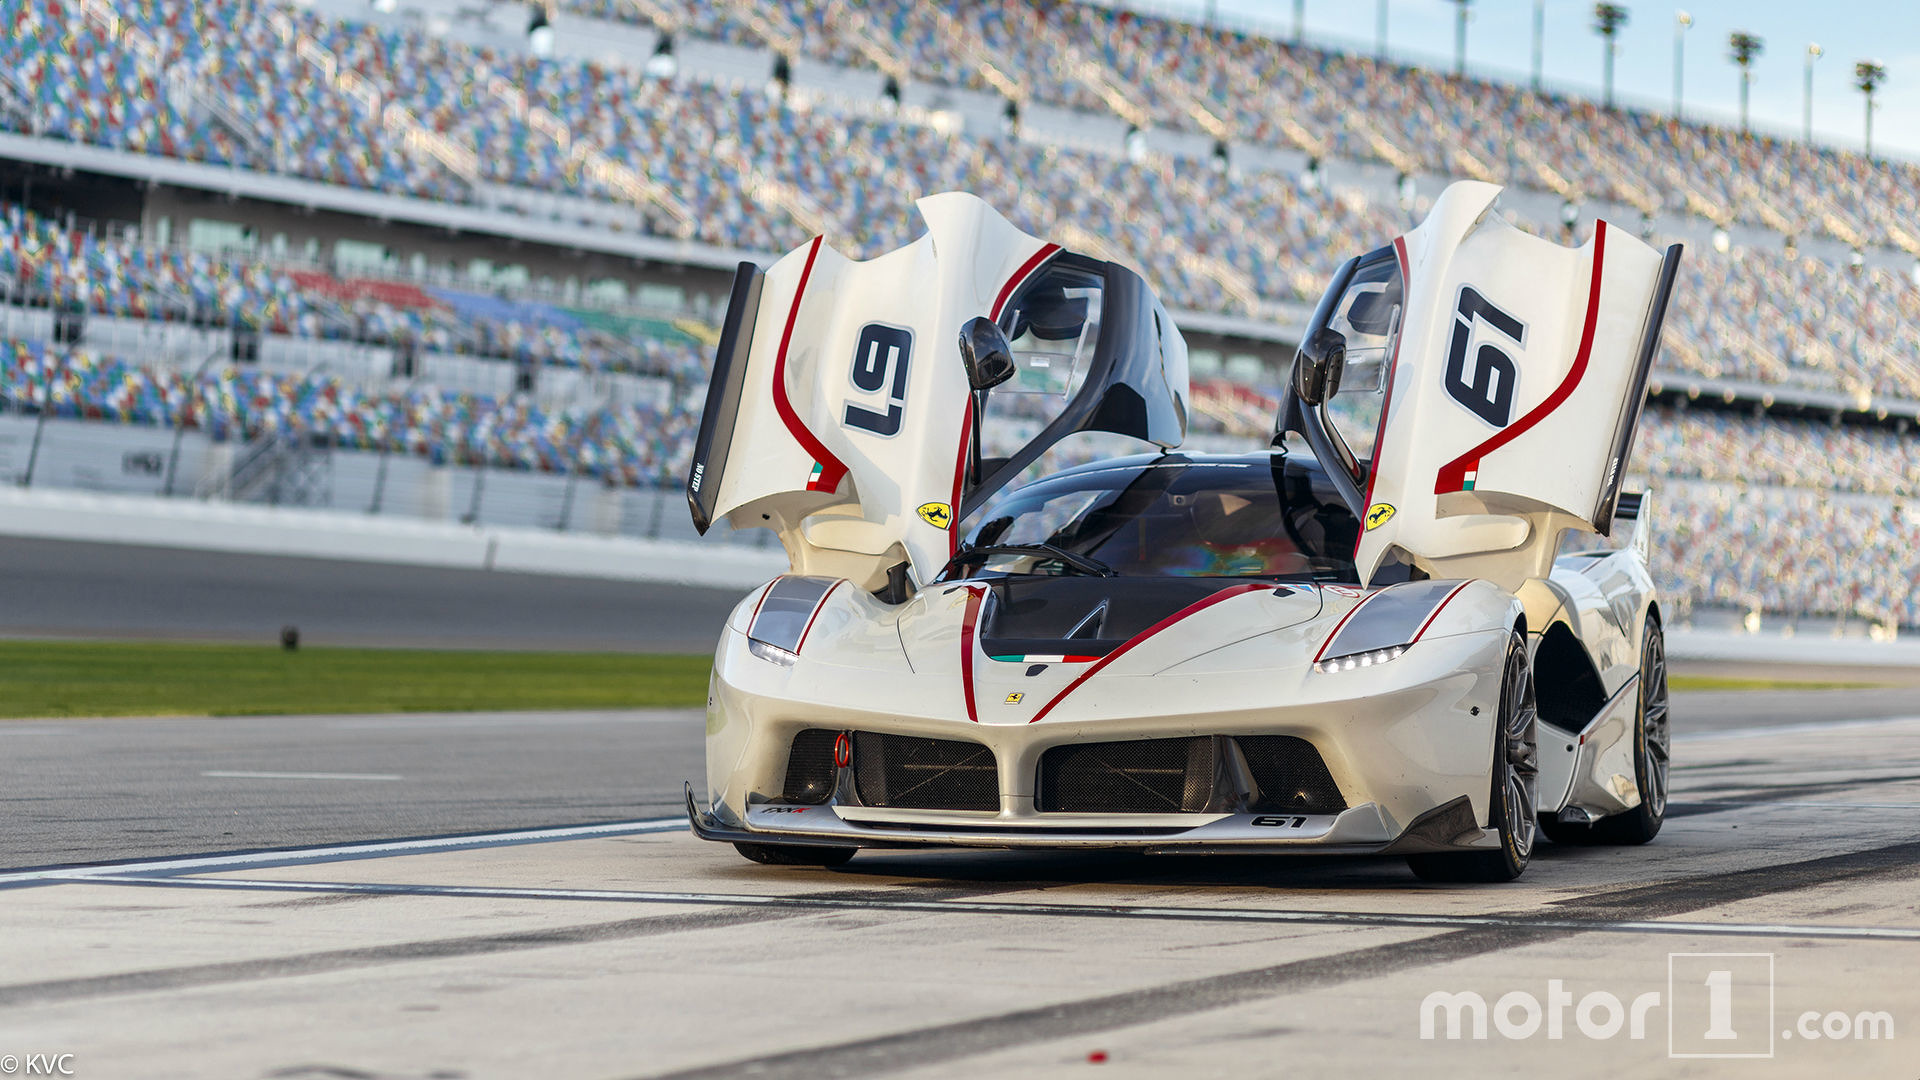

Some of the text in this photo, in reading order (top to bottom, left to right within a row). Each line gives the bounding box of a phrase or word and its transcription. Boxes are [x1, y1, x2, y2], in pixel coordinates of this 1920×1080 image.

[843, 322, 914, 438] 61
[1442, 284, 1527, 430] 61
[1250, 815, 1308, 829] 61
